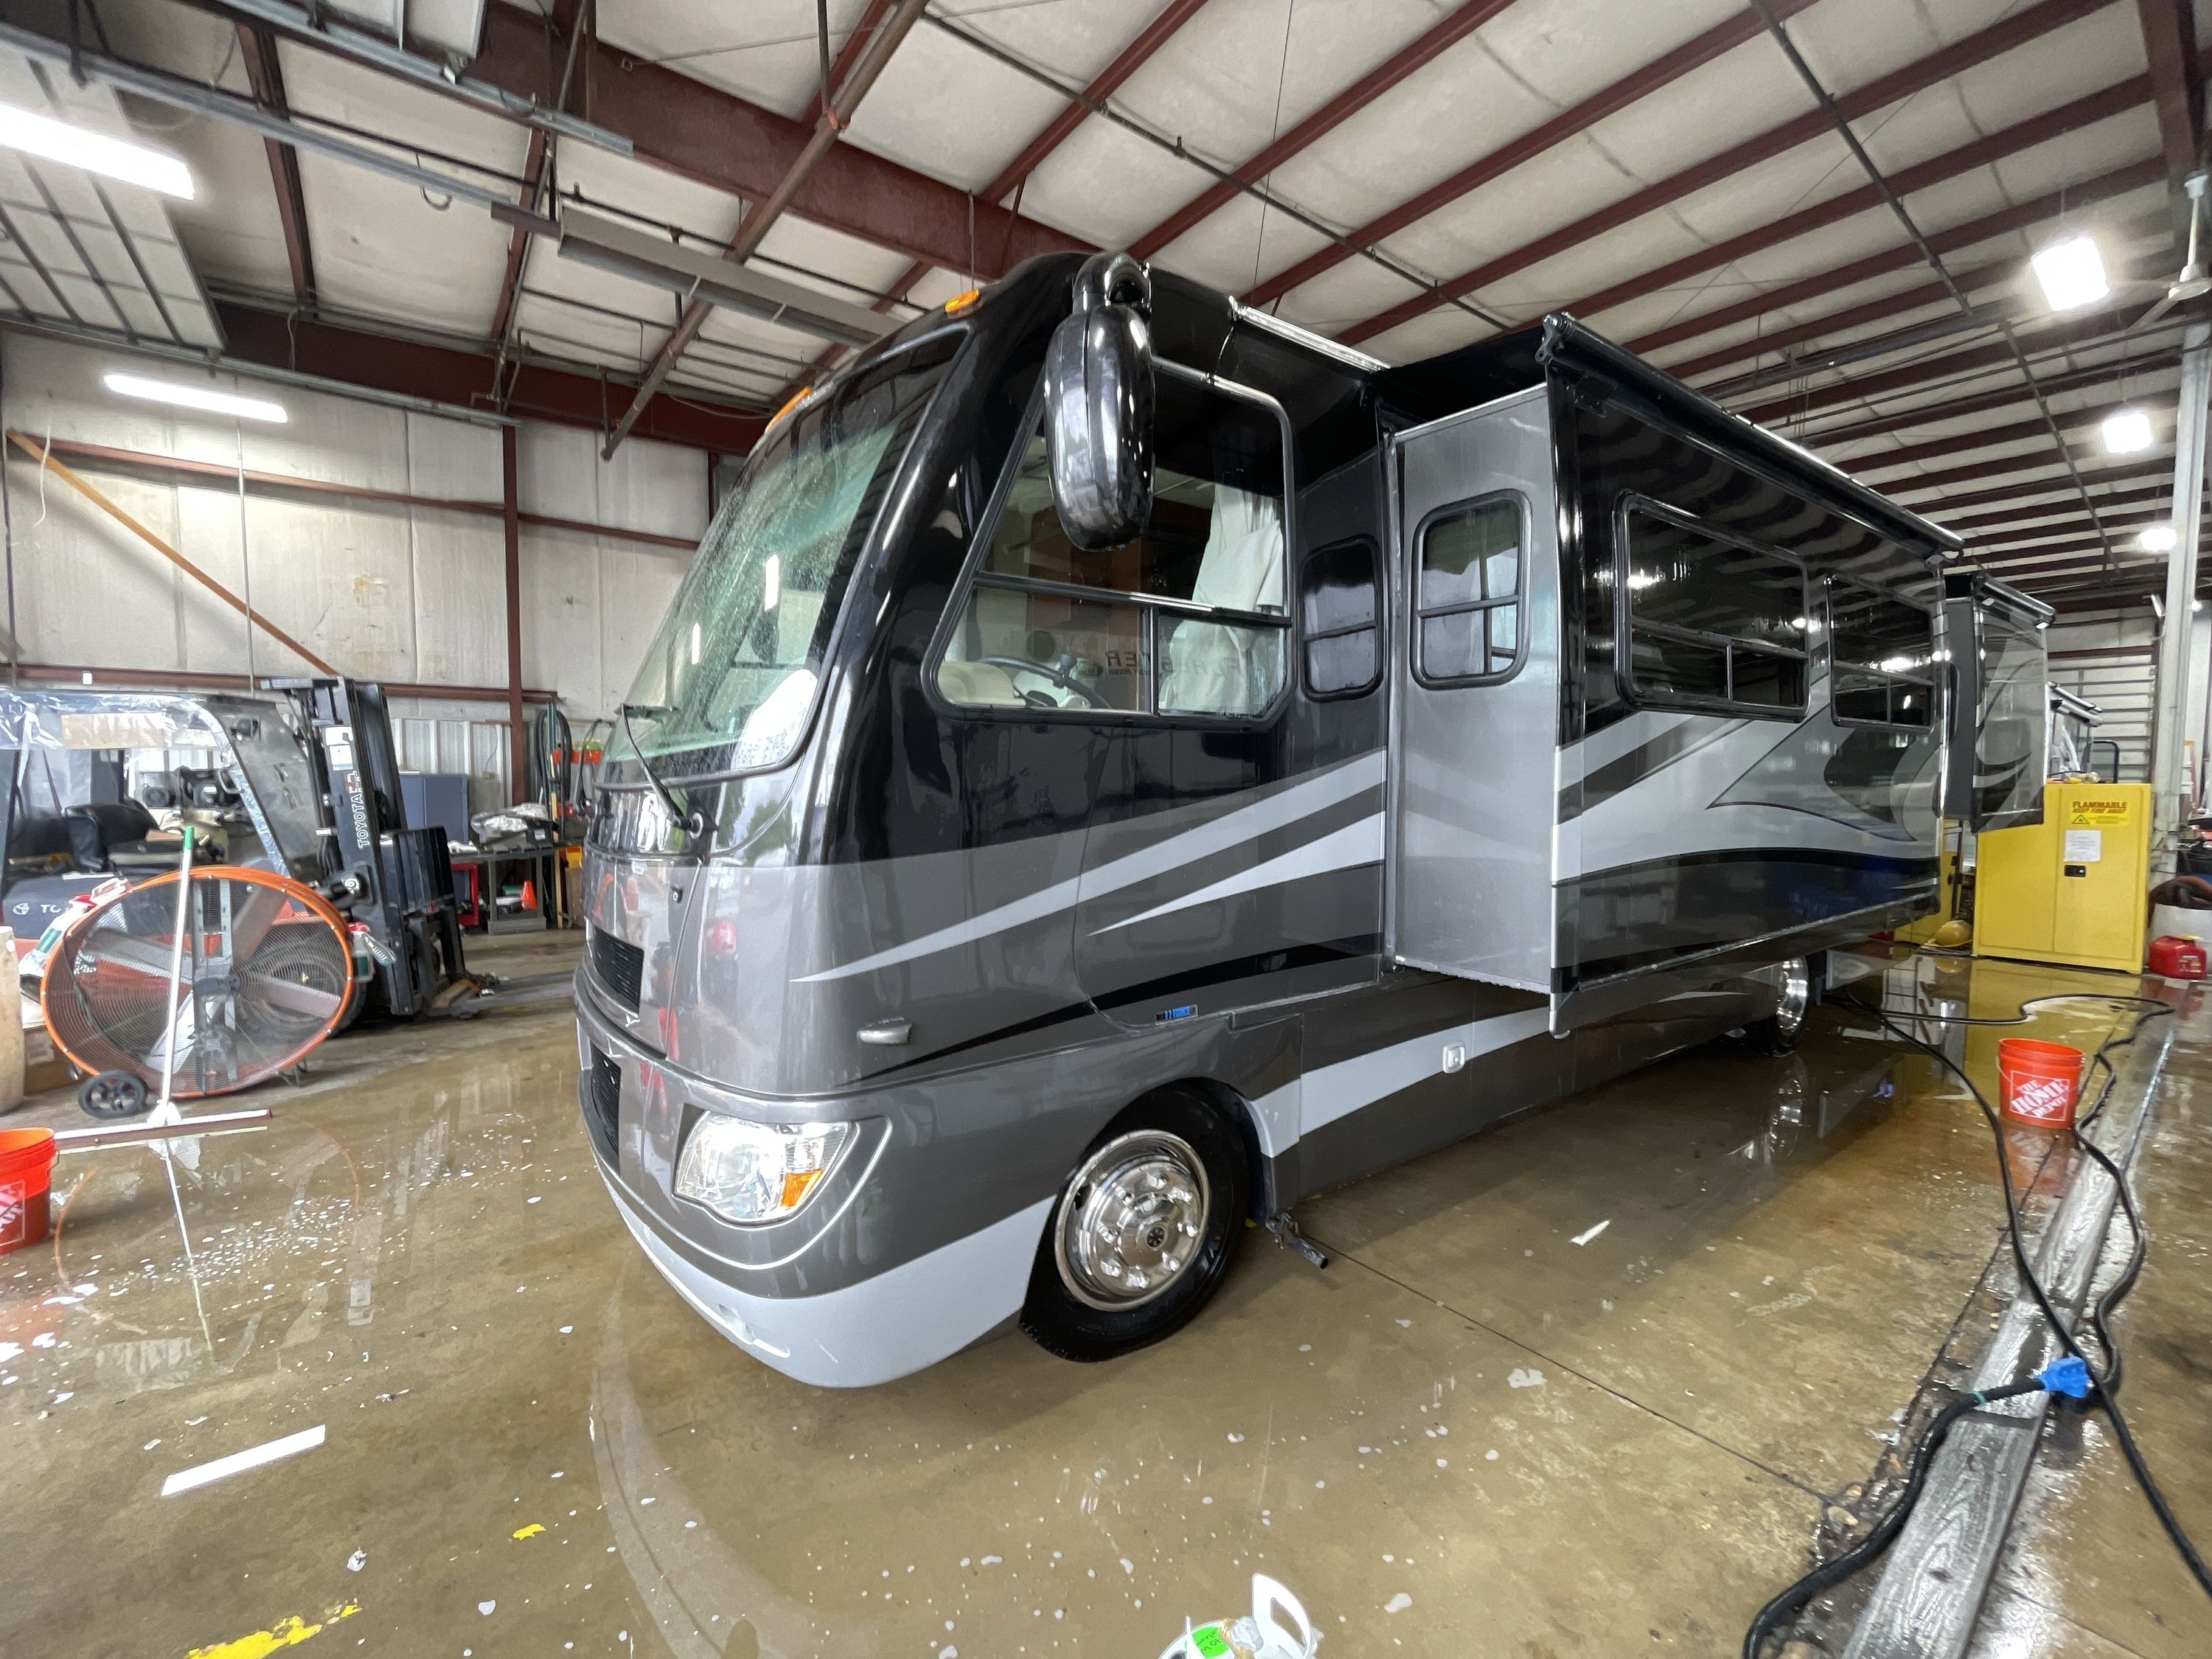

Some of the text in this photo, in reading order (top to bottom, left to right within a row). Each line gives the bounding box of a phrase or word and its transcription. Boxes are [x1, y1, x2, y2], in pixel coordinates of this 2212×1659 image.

[351, 793, 370, 849] TOYOTA
[2011, 1079, 2069, 1113] HOME
[2016, 1079, 2042, 1091] THE
[2031, 1096, 2068, 1117] DEPOT
